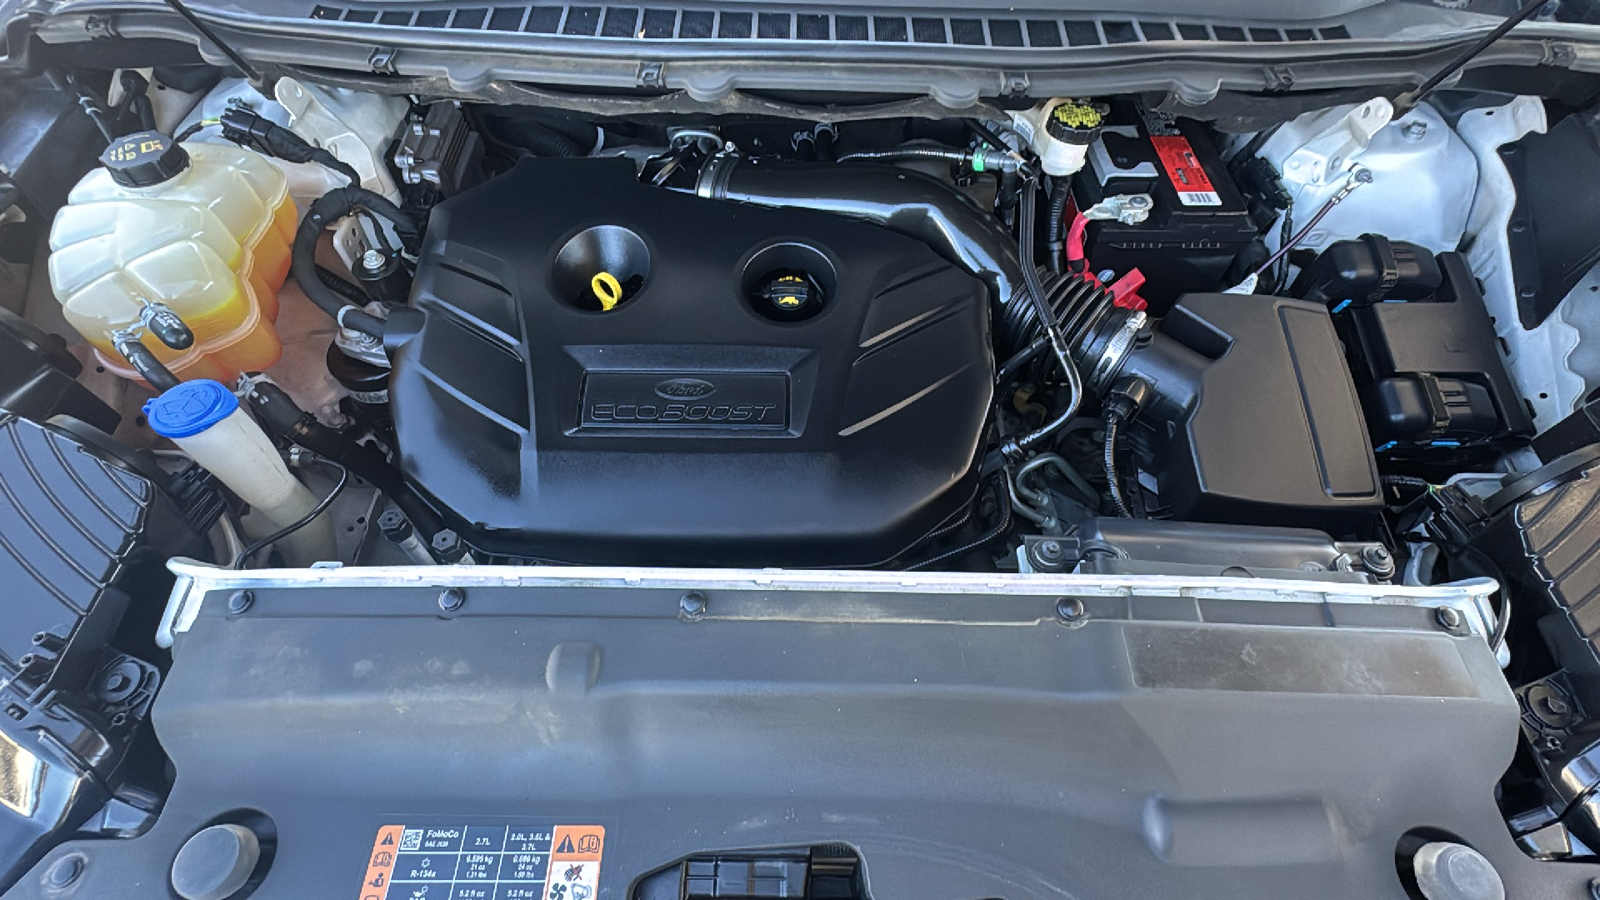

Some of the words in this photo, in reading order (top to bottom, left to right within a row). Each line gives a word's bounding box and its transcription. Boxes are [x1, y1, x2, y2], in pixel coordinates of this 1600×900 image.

[666, 381, 705, 396] Ford
[591, 403, 777, 421] ECOBOOST
[426, 829, 459, 838] FoMoCo
[474, 837, 491, 846] 2.7L
[521, 843, 537, 851] 3.7L
[410, 869, 437, 878] R-134a
[459, 889, 470, 898] 5.2
[507, 889, 518, 898] 5.2
